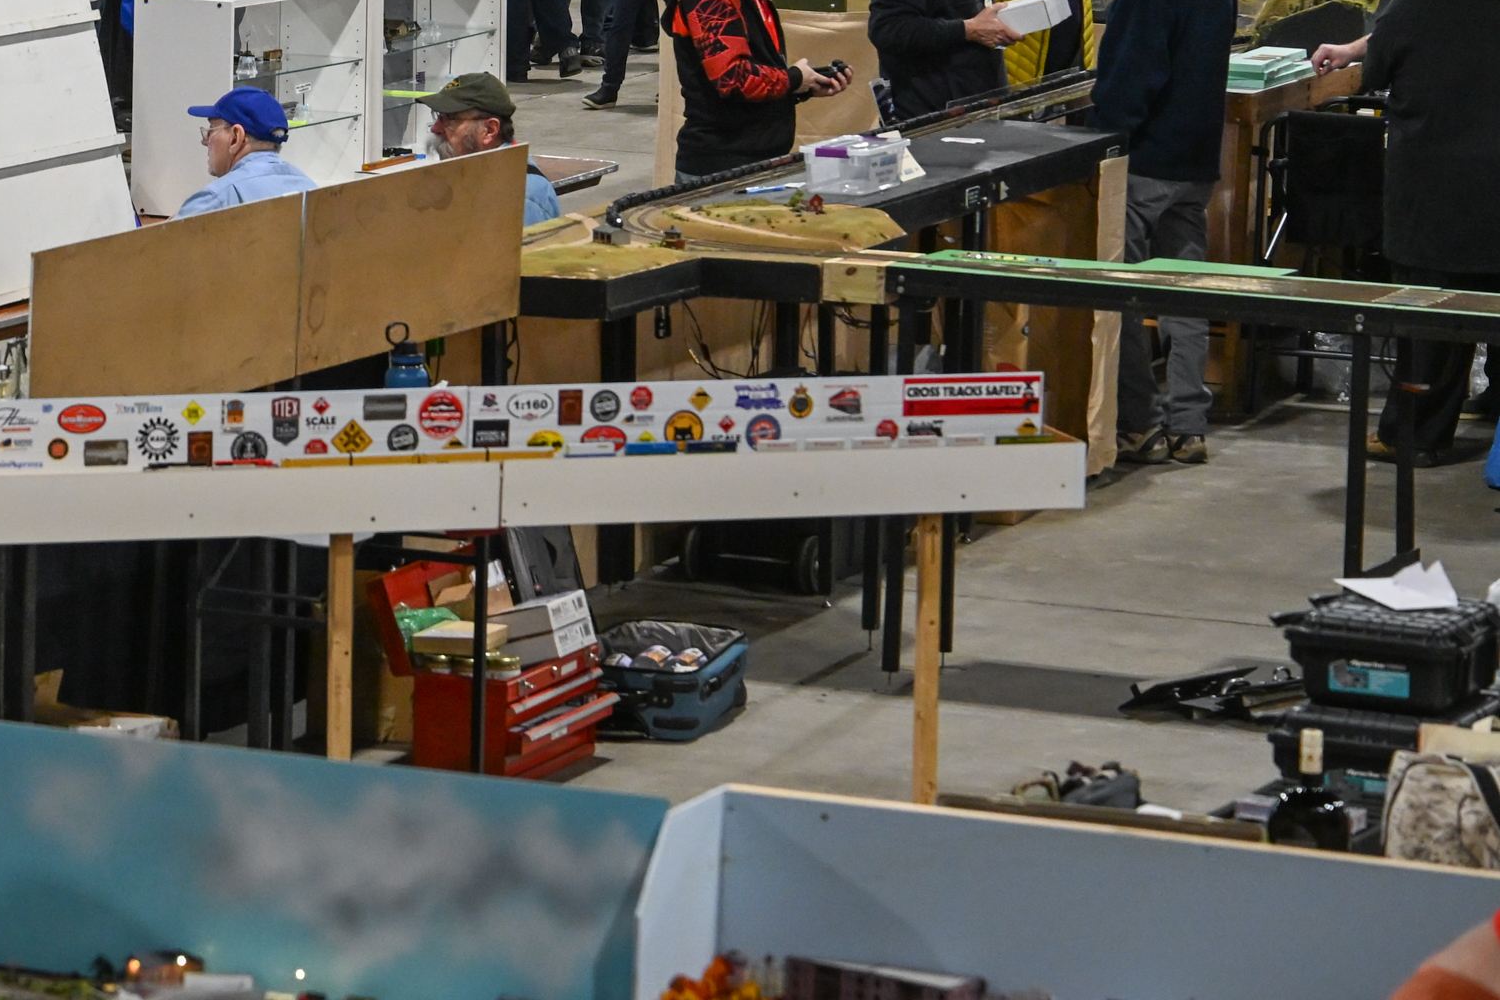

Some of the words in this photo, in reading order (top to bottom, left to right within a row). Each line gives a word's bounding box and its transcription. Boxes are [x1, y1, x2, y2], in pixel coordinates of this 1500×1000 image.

[907, 387, 940, 397] CROSS
[943, 386, 982, 397] TRACKS
[985, 385, 1022, 396] SAFELY
[274, 401, 298, 417] TTEX
[514, 400, 548, 410] 1:160
[306, 416, 336, 426] SCALE
